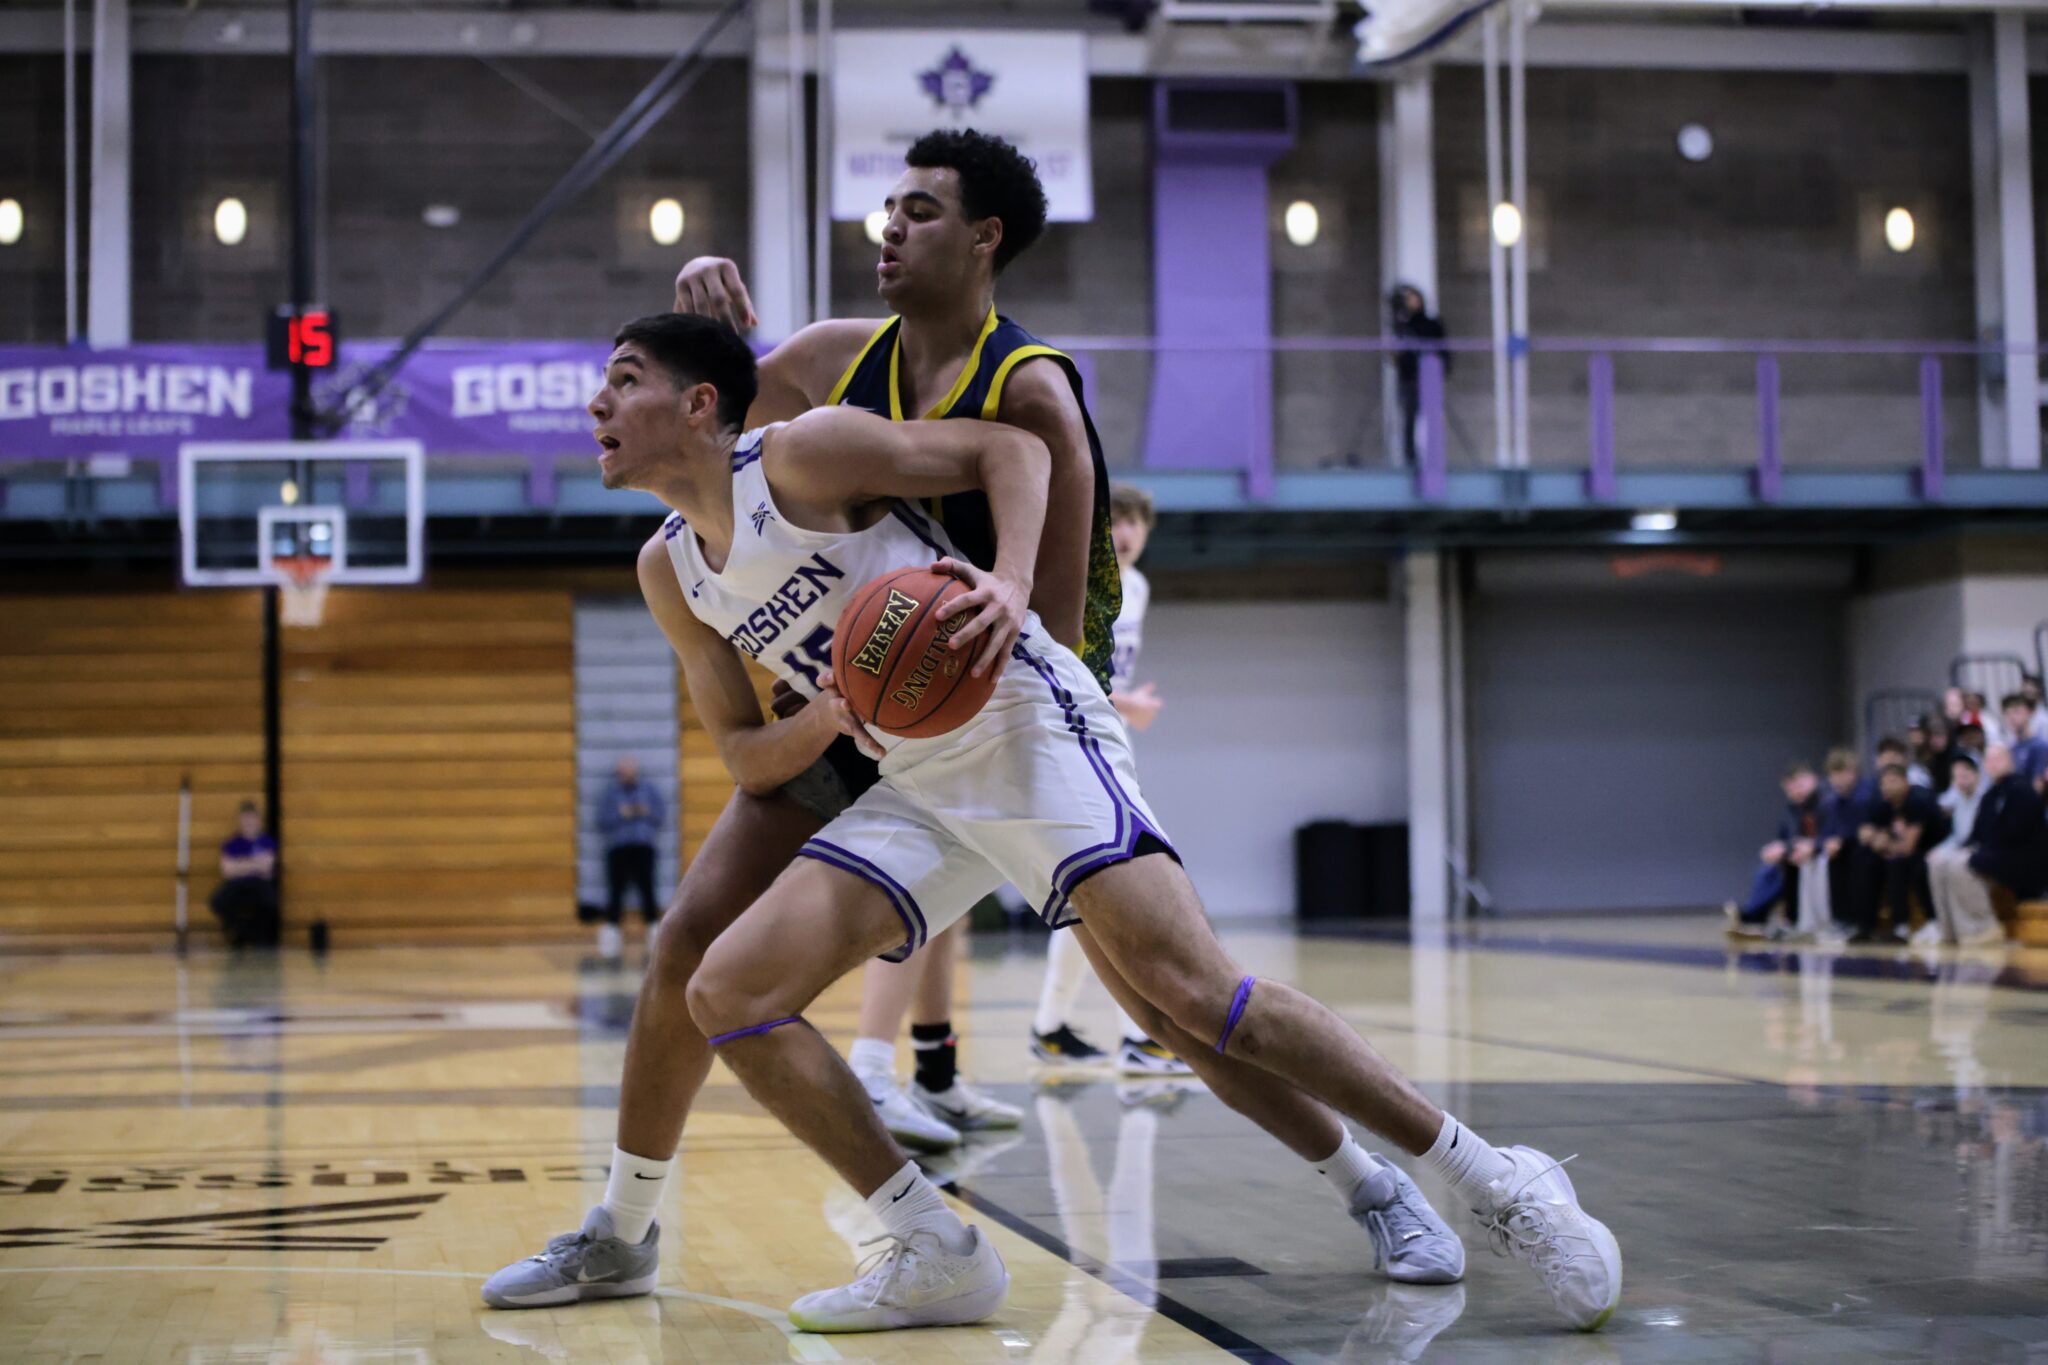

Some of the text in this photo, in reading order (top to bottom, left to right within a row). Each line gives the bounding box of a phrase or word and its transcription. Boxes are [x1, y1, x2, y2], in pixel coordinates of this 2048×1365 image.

[289, 311, 332, 366] 15
[0, 365, 251, 419] GOSHEN
[453, 363, 608, 416] GOSH
[850, 588, 919, 675] NAIA
[890, 602, 967, 711] PALDING
